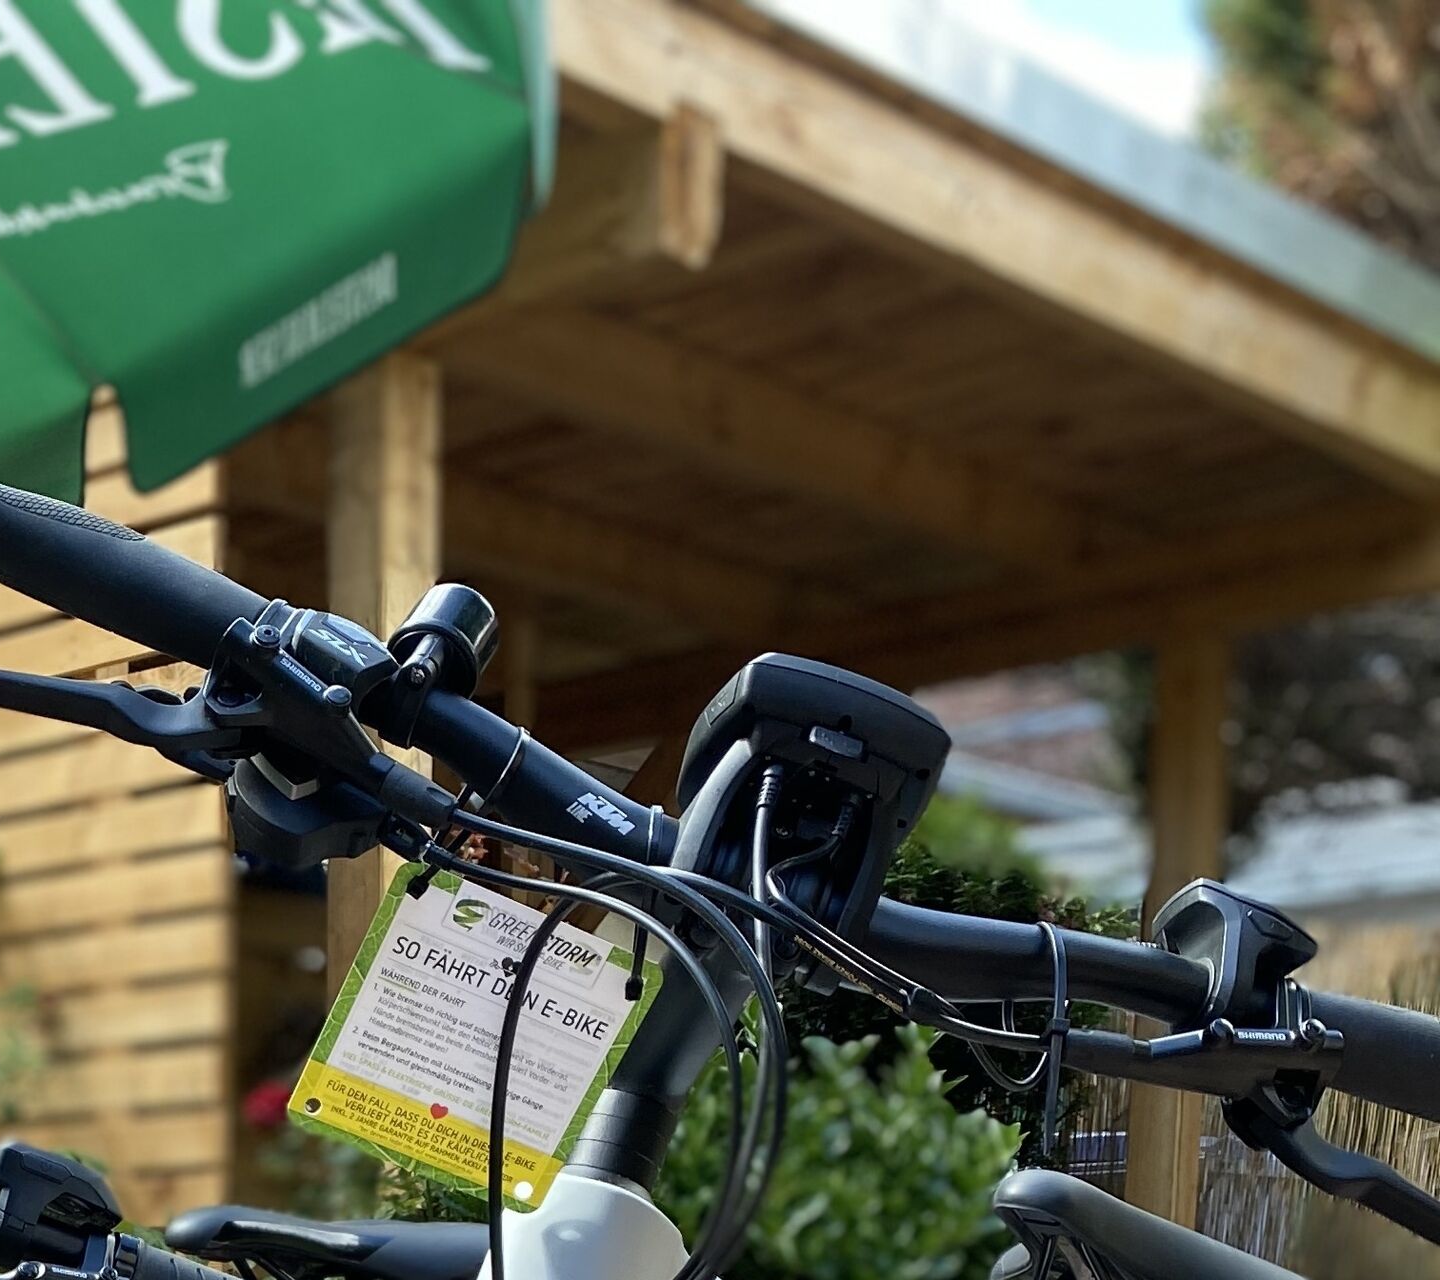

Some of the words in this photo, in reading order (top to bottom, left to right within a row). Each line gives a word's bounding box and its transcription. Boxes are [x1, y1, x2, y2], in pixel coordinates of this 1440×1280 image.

[280, 656, 322, 692] SHIMANO
[577, 792, 636, 836] KTM
[487, 911, 598, 969] GREETORM
[380, 966, 421, 989] WÄHREND
[421, 985, 438, 996] DER
[439, 992, 465, 1008] FAHRT
[382, 987, 396, 997] Wie
[397, 993, 423, 1008] bremse
[423, 1004, 435, 1013] ich
[434, 1009, 458, 1025] richtig
[458, 1019, 472, 1029] und
[391, 935, 421, 960] SO
[423, 944, 492, 989] FÄHRT
[490, 977, 538, 1009] DEN
[541, 999, 608, 1039] E-BIKE
[1237, 1031, 1287, 1041] SHIMANO
[326, 1078, 347, 1094] FÜR
[347, 1088, 366, 1102] DEN
[394, 1106, 420, 1123] DASS
[420, 1117, 434, 1129] DU
[435, 1123, 458, 1139] DICH
[458, 1133, 472, 1145] IN
[472, 1138, 492, 1153] DIES
[504, 1151, 535, 1171] E-BIKE
[343, 1096, 388, 1122] VERLIEBT
[417, 1127, 430, 1139] ES
[430, 1132, 447, 1145] IST
[355, 1114, 378, 1129] JAHRE
[378, 1123, 413, 1143] GARANTIE
[414, 1137, 429, 1149] AUF
